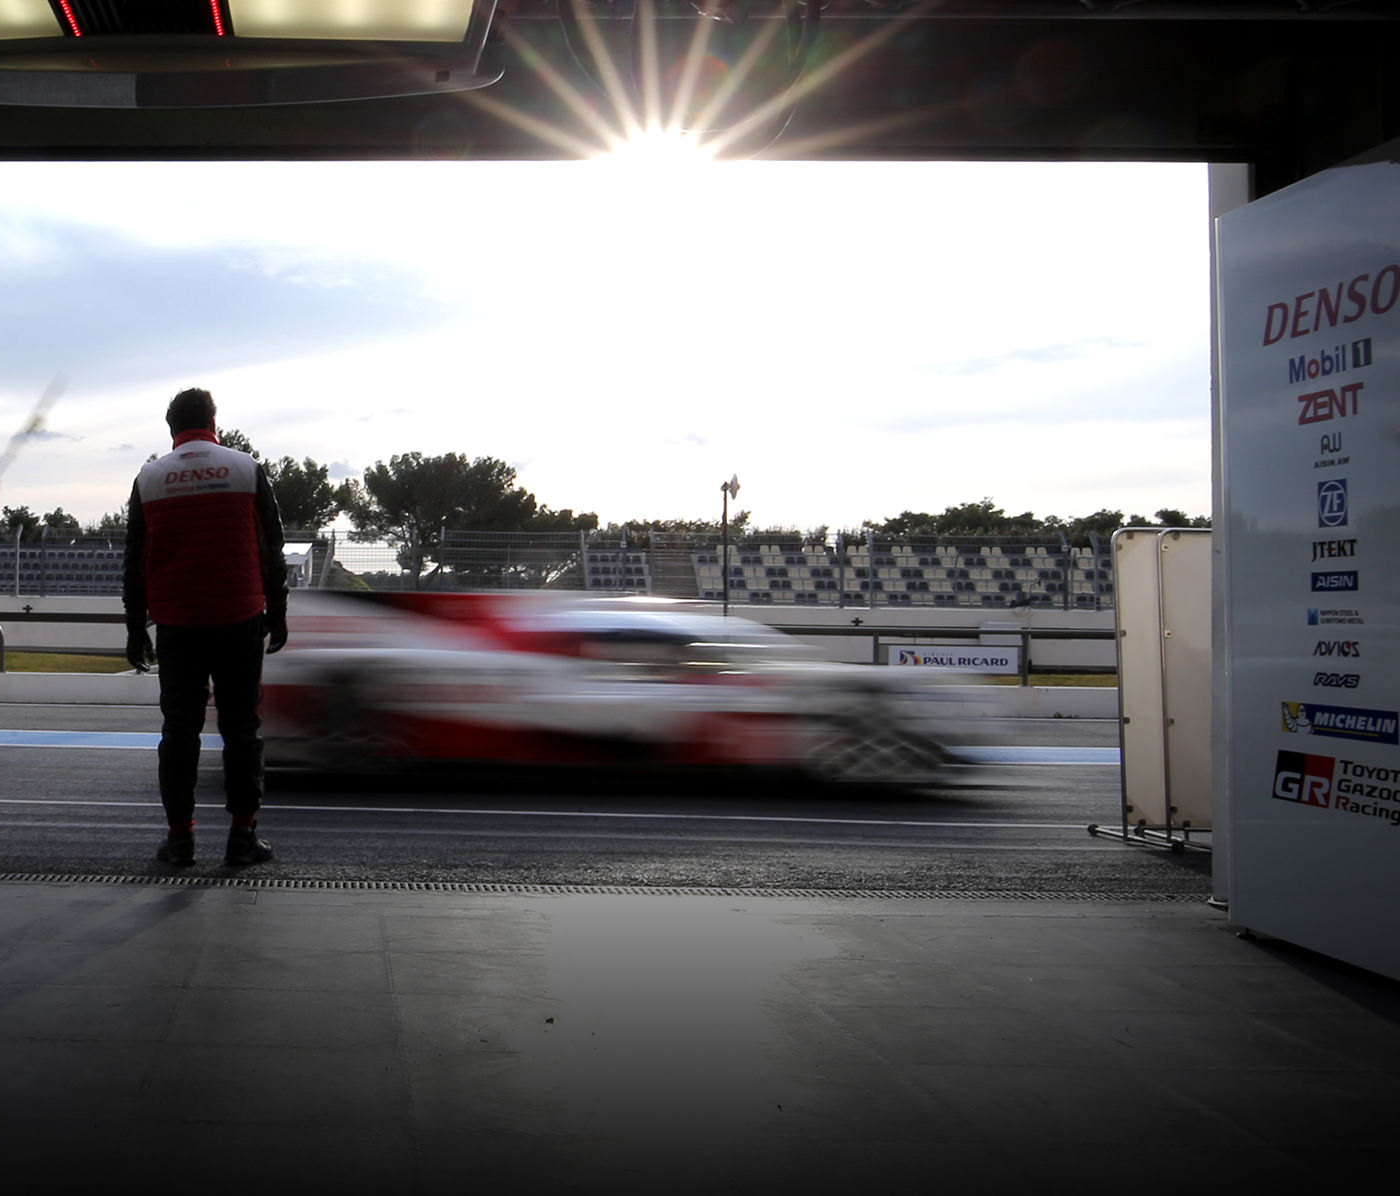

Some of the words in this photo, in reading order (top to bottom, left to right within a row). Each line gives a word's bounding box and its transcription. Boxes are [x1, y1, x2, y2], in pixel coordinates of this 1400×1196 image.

[1262, 264, 1400, 347] DENSO
[1289, 344, 1347, 384] Mobil
[1354, 339, 1369, 367] 1
[1297, 382, 1364, 425] ZENT
[1314, 458, 1336, 469] AISIN
[1336, 456, 1350, 466] AW
[164, 466, 229, 485] DENSO
[1311, 539, 1358, 561] JTEKT
[1315, 574, 1354, 588] AISIN
[923, 656, 956, 666] PAUL
[958, 657, 1009, 667] RICARD
[1313, 672, 1360, 688] RAYS
[1314, 711, 1397, 734] MICHELIN
[1340, 760, 1400, 783] TOYOT
[1274, 771, 1331, 808] GR
[1335, 796, 1400, 826] Racing
